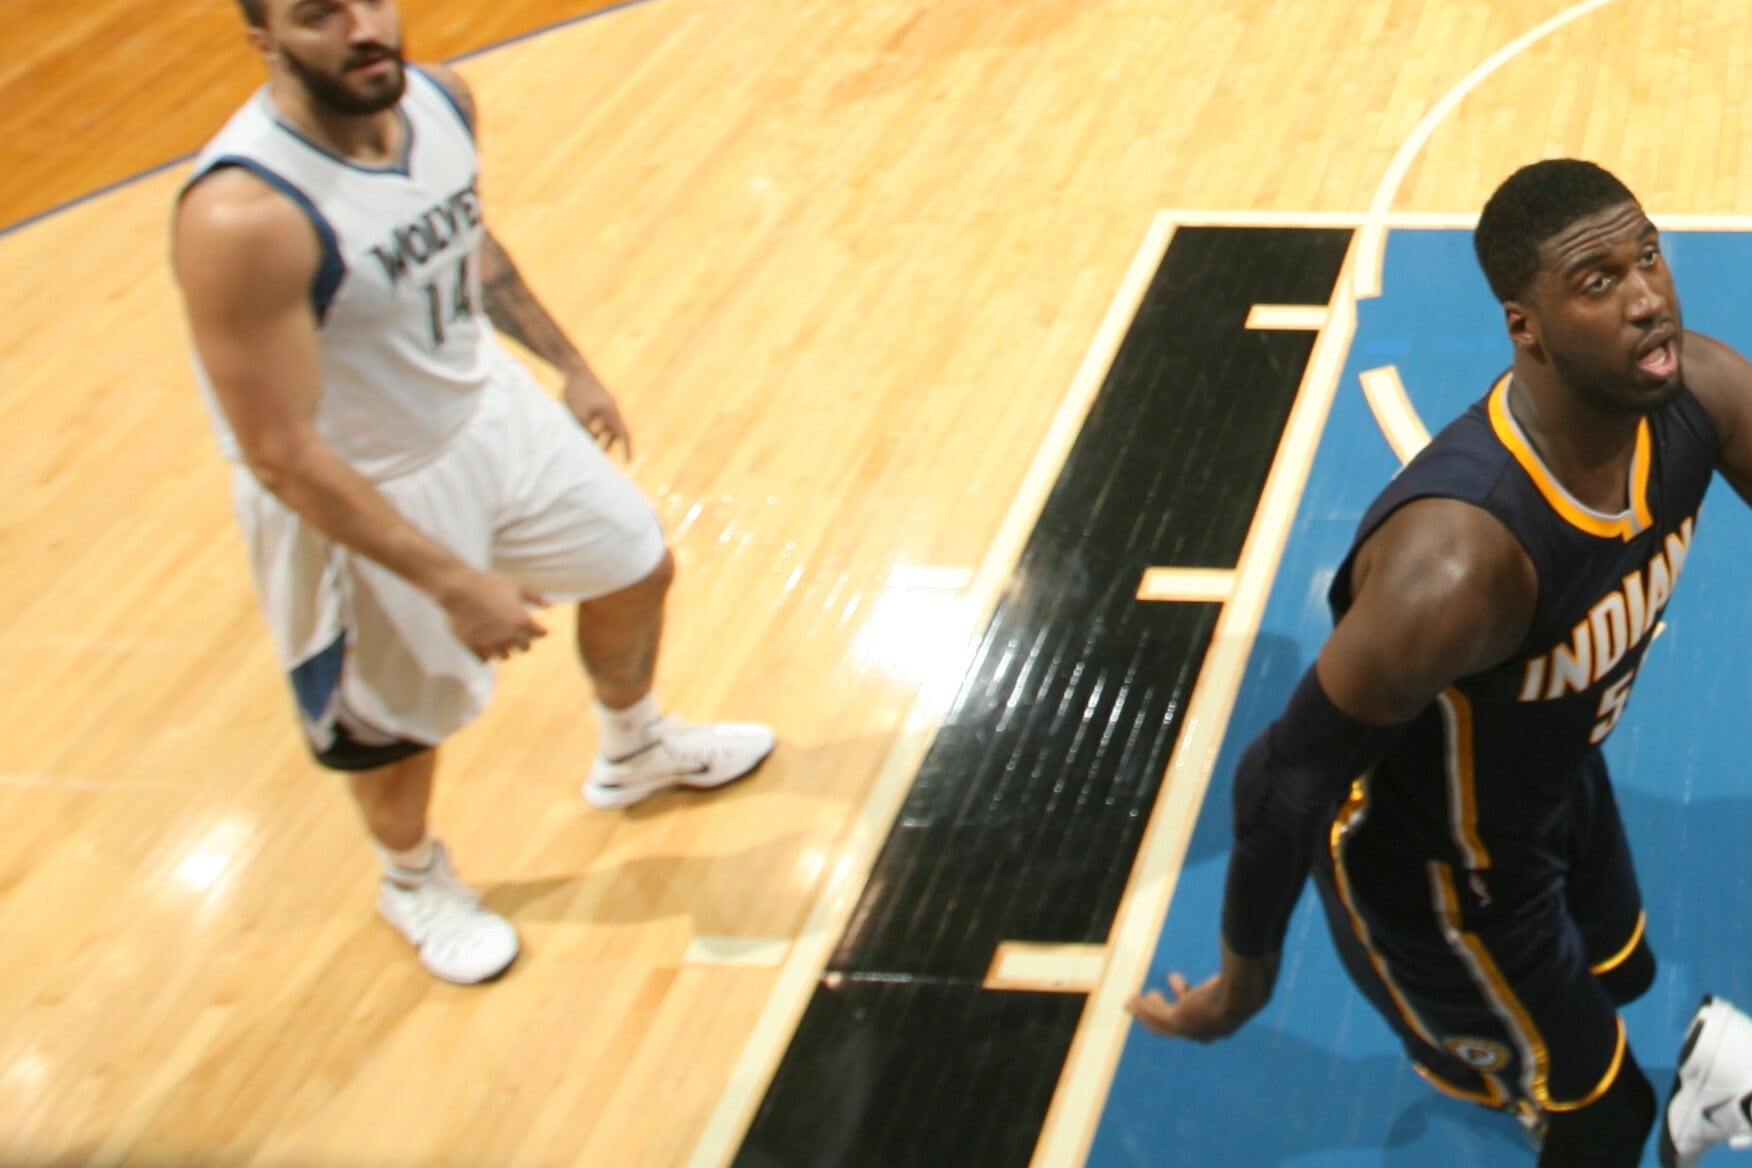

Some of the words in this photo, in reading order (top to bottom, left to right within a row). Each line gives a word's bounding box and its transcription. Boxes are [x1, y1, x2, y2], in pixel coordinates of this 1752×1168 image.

[368, 176, 479, 289] WOLVE
[425, 255, 472, 344] 14
[1517, 517, 1693, 702] INDIAN
